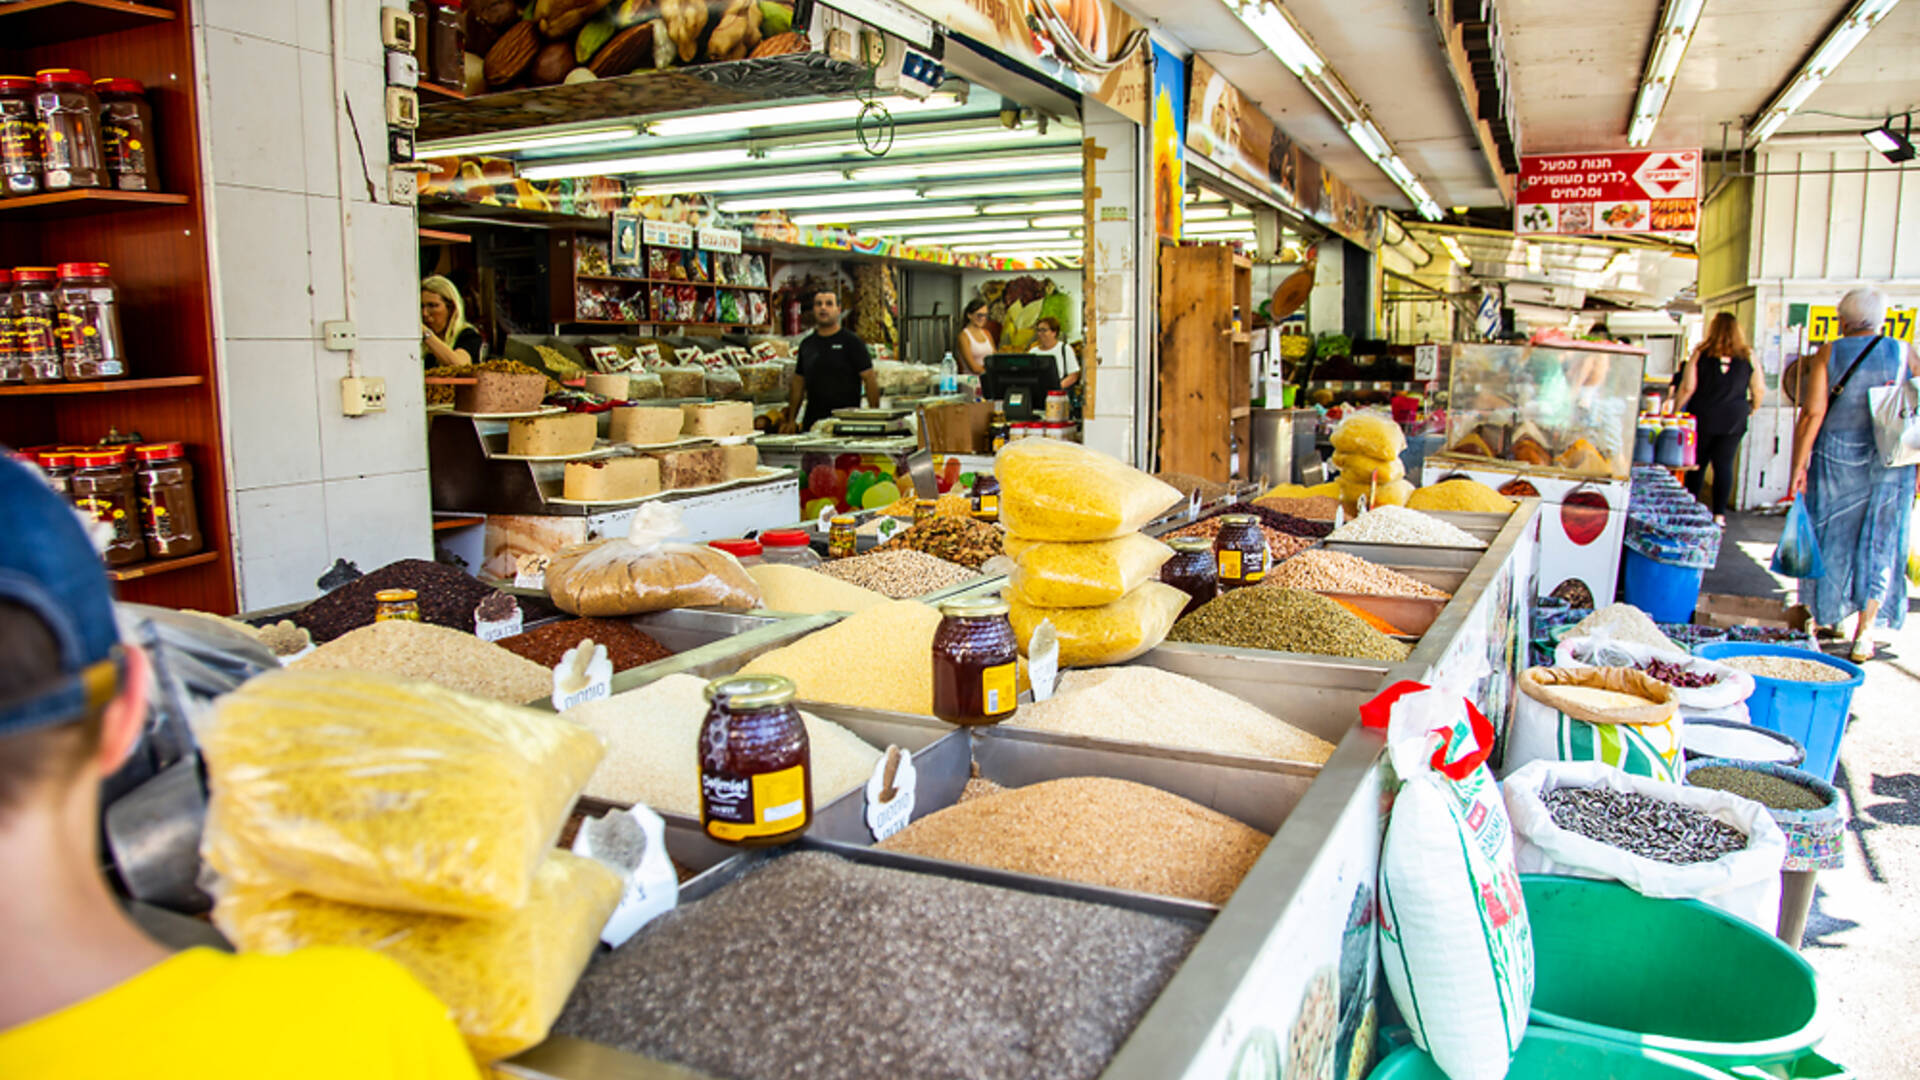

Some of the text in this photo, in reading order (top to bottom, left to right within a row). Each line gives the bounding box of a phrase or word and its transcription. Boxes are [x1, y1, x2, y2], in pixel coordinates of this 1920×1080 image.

[1538, 158, 1612, 171] חנות מפעל
[1527, 173, 1585, 187] מעושנים
[1550, 186, 1602, 199] ומלוחים
